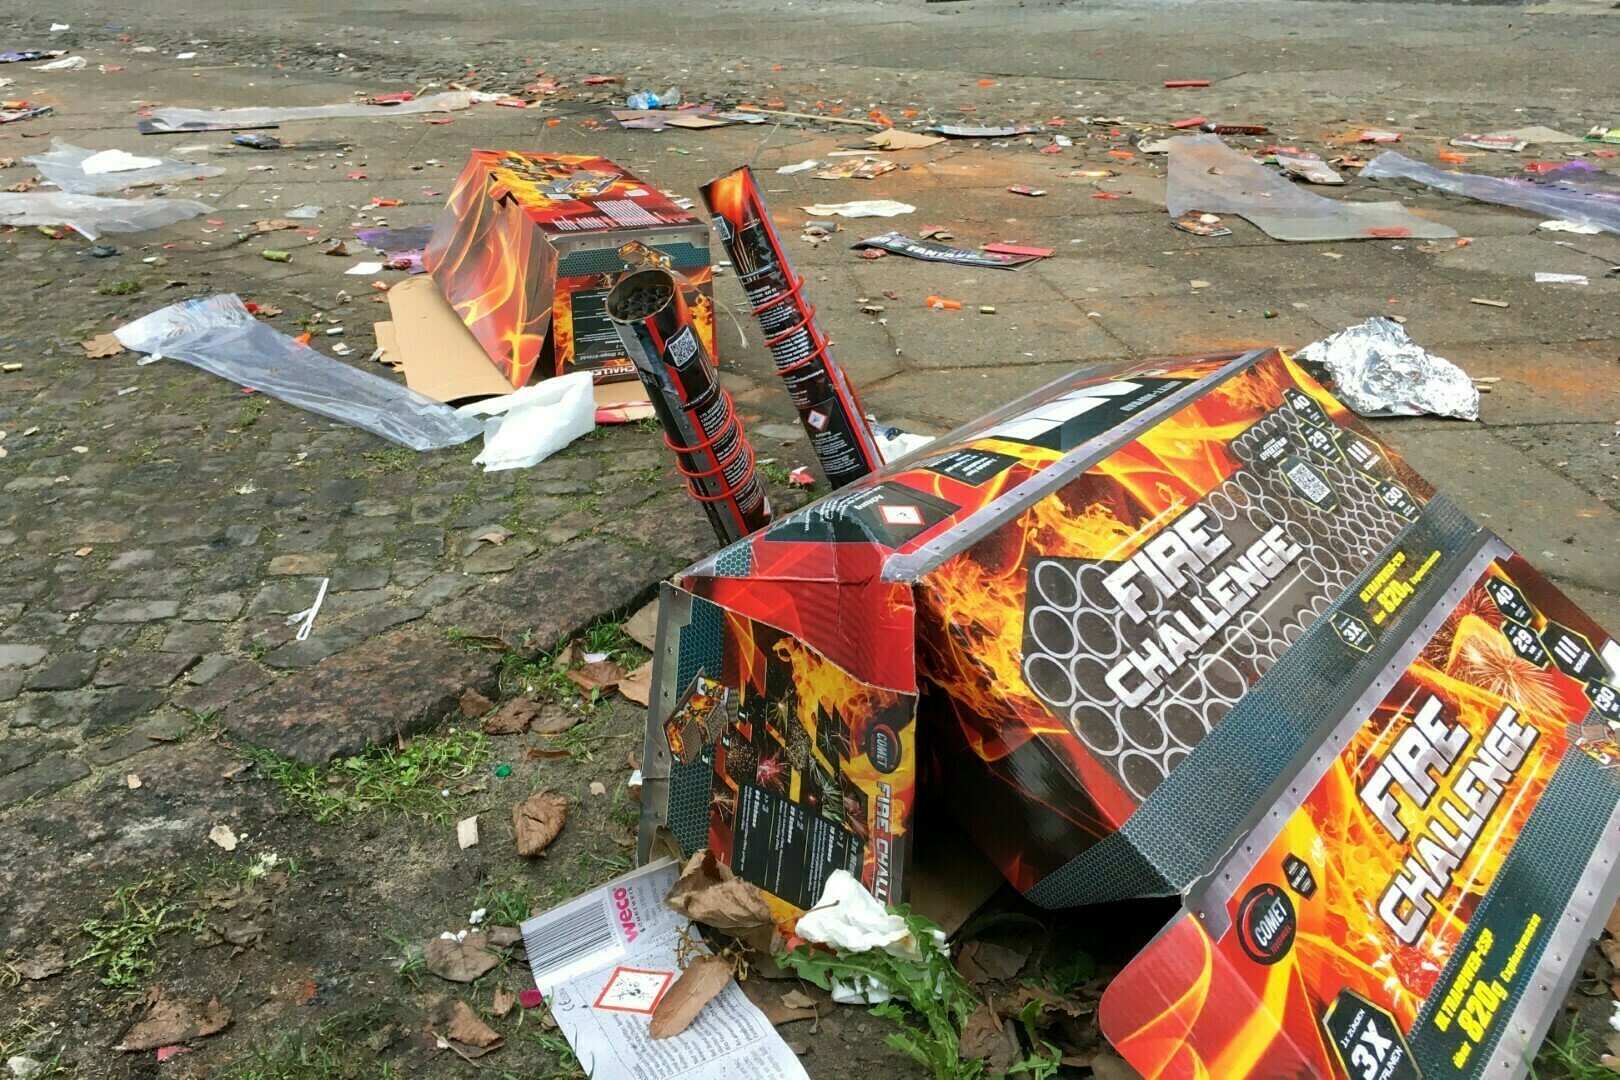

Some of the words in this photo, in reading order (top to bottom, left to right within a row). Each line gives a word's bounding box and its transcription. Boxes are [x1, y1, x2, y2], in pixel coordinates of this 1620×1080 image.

[1292, 395, 1311, 410] 40
[1308, 430, 1328, 449] 29
[1383, 486, 1404, 507] 130
[1101, 506, 1233, 625] FIRE
[1104, 524, 1304, 709] CHALLENGE
[1496, 585, 1514, 606] 40
[1342, 621, 1363, 641] 3X
[1512, 628, 1533, 653] 29
[1594, 685, 1616, 712] 130
[875, 731, 888, 769] COMET
[1358, 693, 1472, 844] FIRE
[760, 803, 770, 813] 3
[795, 820, 804, 830] 2
[875, 781, 892, 833] FIRE
[1377, 702, 1541, 946] CHALLENGE
[614, 887, 638, 943] weco
[628, 886, 646, 933] feuerwerk
[1254, 896, 1288, 947] COMET
[1500, 913, 1542, 983] Explosivmasse
[1433, 927, 1495, 1033] ULTRAPOWER-ESP
[1457, 979, 1509, 1043] 820g
[1351, 1018, 1393, 1080] 3X
[1452, 1040, 1472, 1070] über
